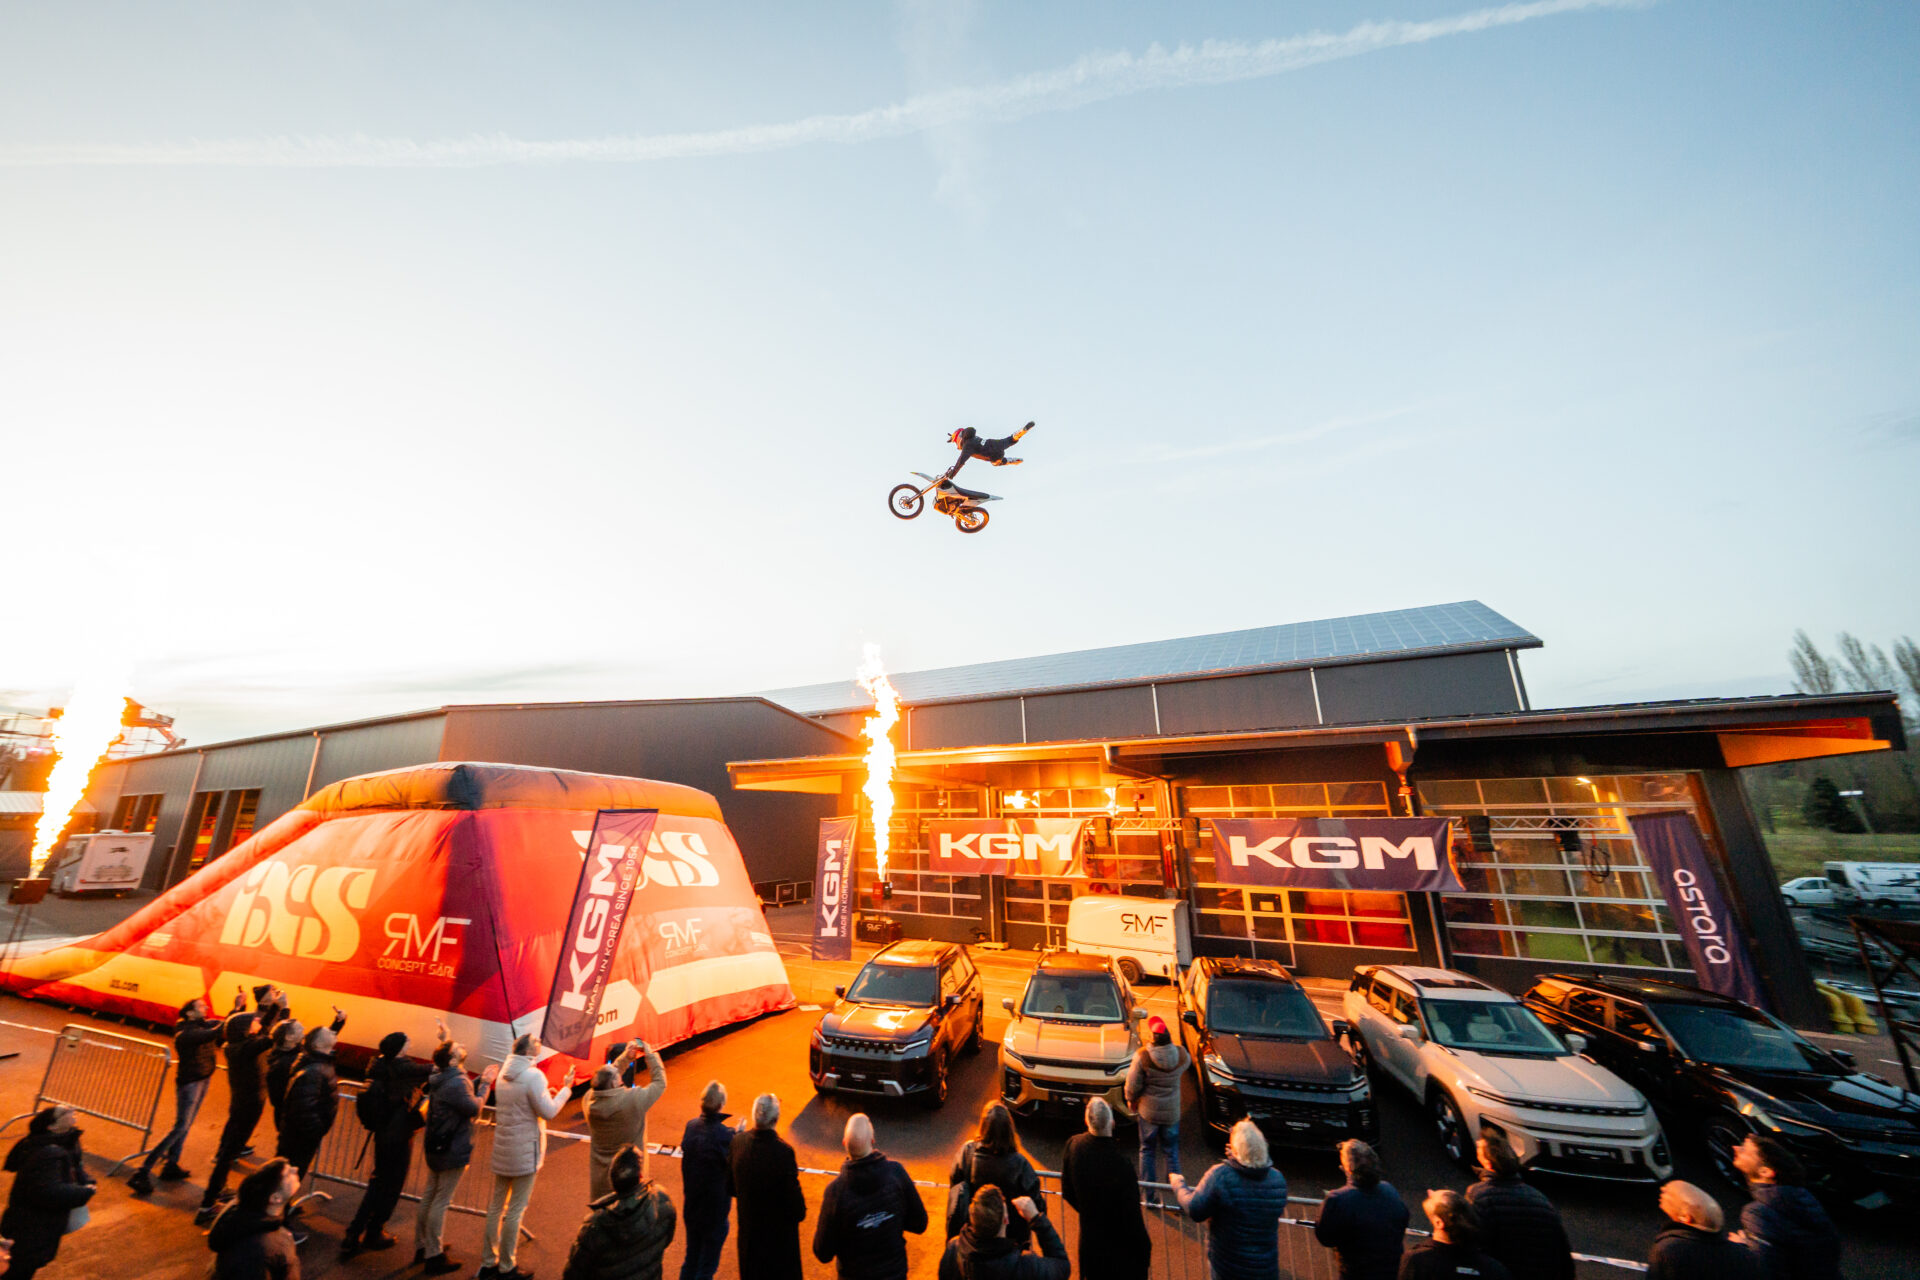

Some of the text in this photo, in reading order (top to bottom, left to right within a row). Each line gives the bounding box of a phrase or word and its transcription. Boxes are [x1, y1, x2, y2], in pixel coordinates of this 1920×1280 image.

[940, 833, 1073, 860] KGM
[1229, 836, 1439, 870] KGM
[821, 840, 842, 937] KGM
[840, 915, 848, 938] MADE
[841, 905, 848, 914] IN
[1673, 868, 1732, 964] astara
[560, 843, 626, 1011] KGM
[586, 846, 639, 1015] MADE IN KOREA SINCE 1954
[377, 958, 427, 973] CONCEPT
